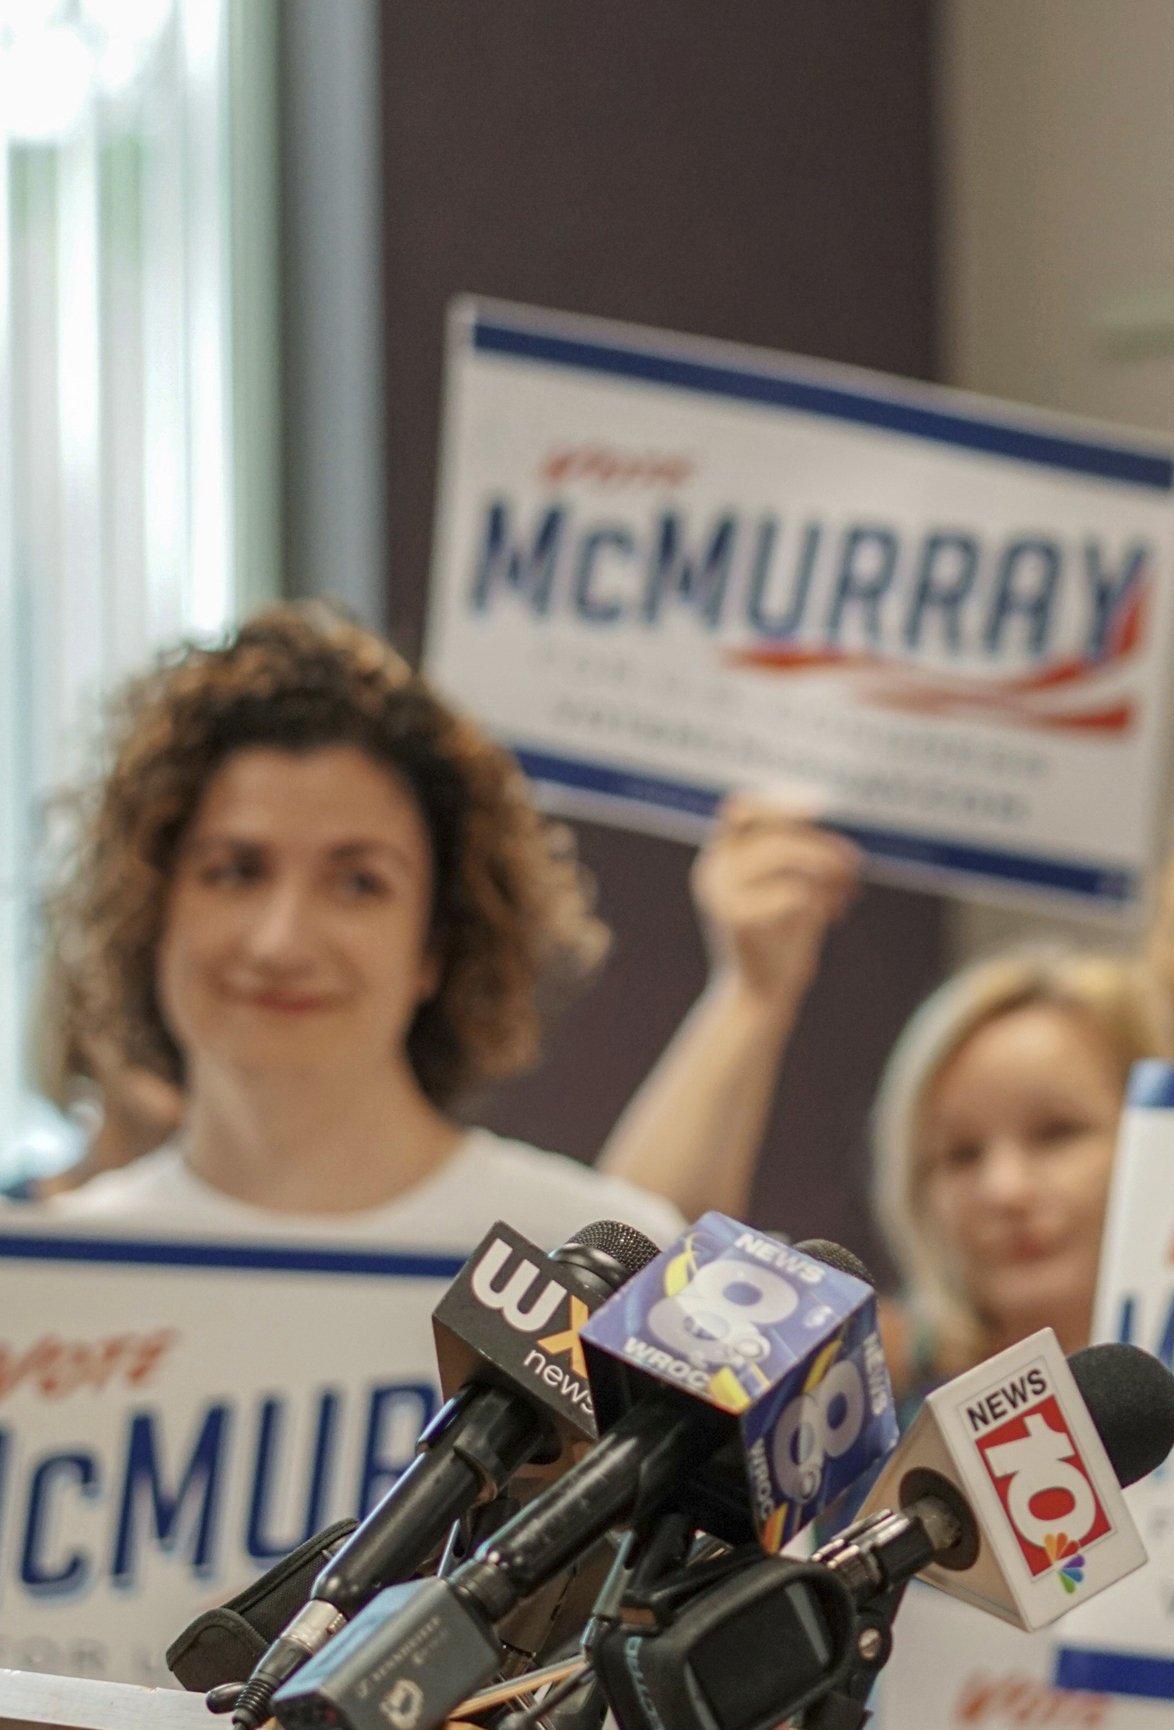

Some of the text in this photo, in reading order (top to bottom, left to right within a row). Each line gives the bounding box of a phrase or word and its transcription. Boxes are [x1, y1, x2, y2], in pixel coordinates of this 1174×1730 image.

[468, 492, 1152, 664] McMURRAY
[733, 1232, 828, 1285] NEWS
[624, 1336, 713, 1392] WROC
[966, 1368, 1048, 1432] NEWS
[0, 1380, 440, 1598] cMUR
[984, 1413, 1097, 1552] 10
